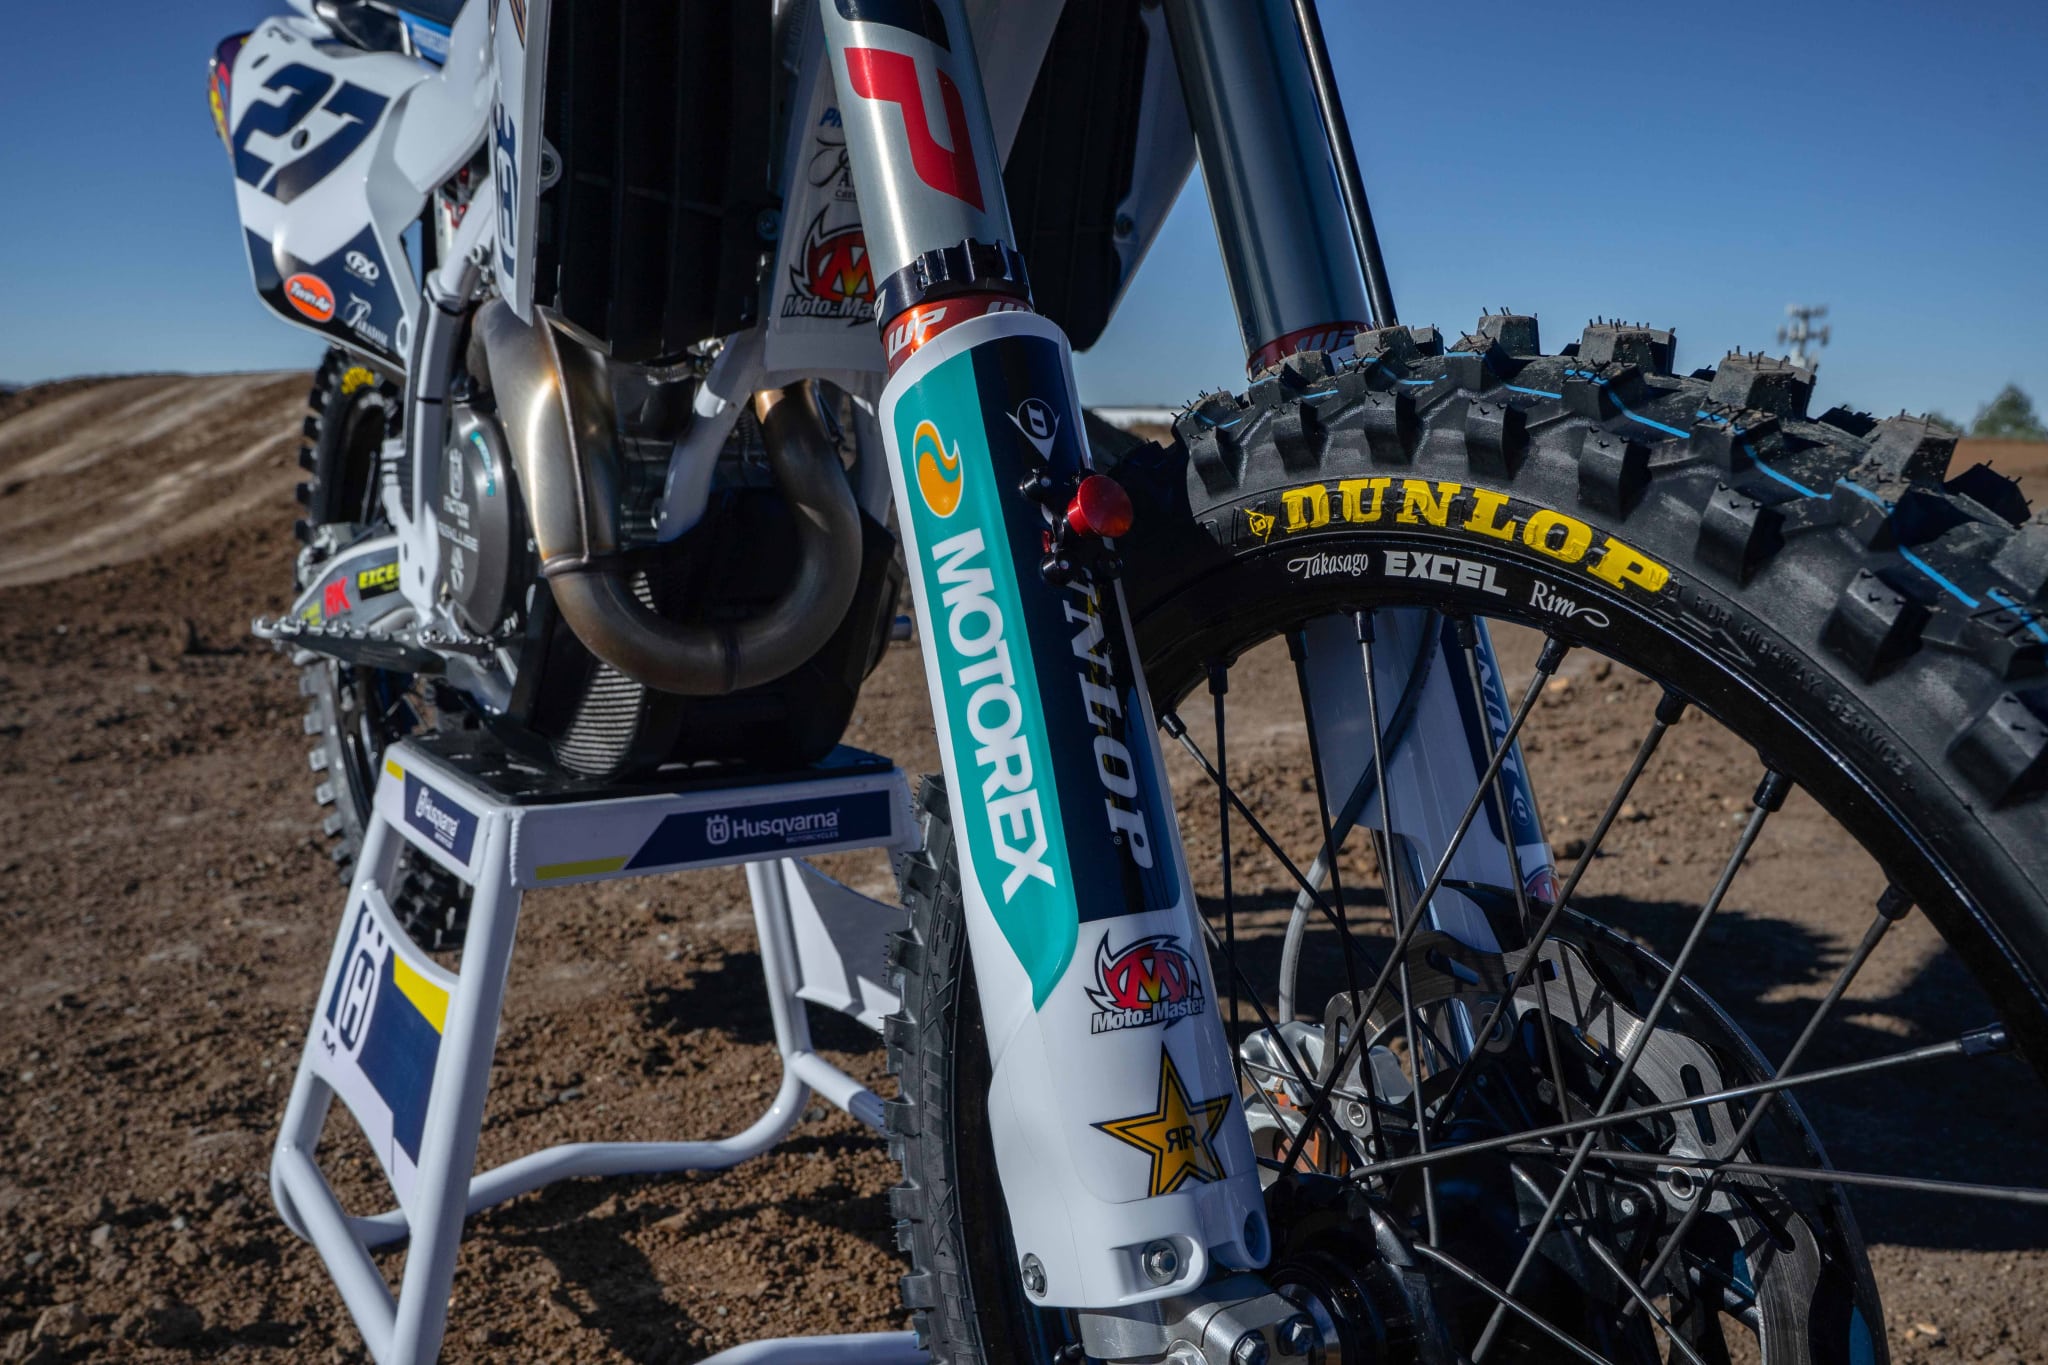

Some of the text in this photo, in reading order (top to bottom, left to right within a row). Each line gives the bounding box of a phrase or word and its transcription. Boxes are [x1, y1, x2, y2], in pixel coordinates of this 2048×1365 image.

[1280, 477, 1671, 593] DUNLOP
[324, 576, 352, 619] RK
[1287, 552, 1369, 579] Takasago
[1383, 550, 1507, 597] EXCEL
[1529, 580, 1610, 628] Rim
[932, 528, 1056, 904] MOTOREX
[732, 810, 839, 839] Husqvarna
